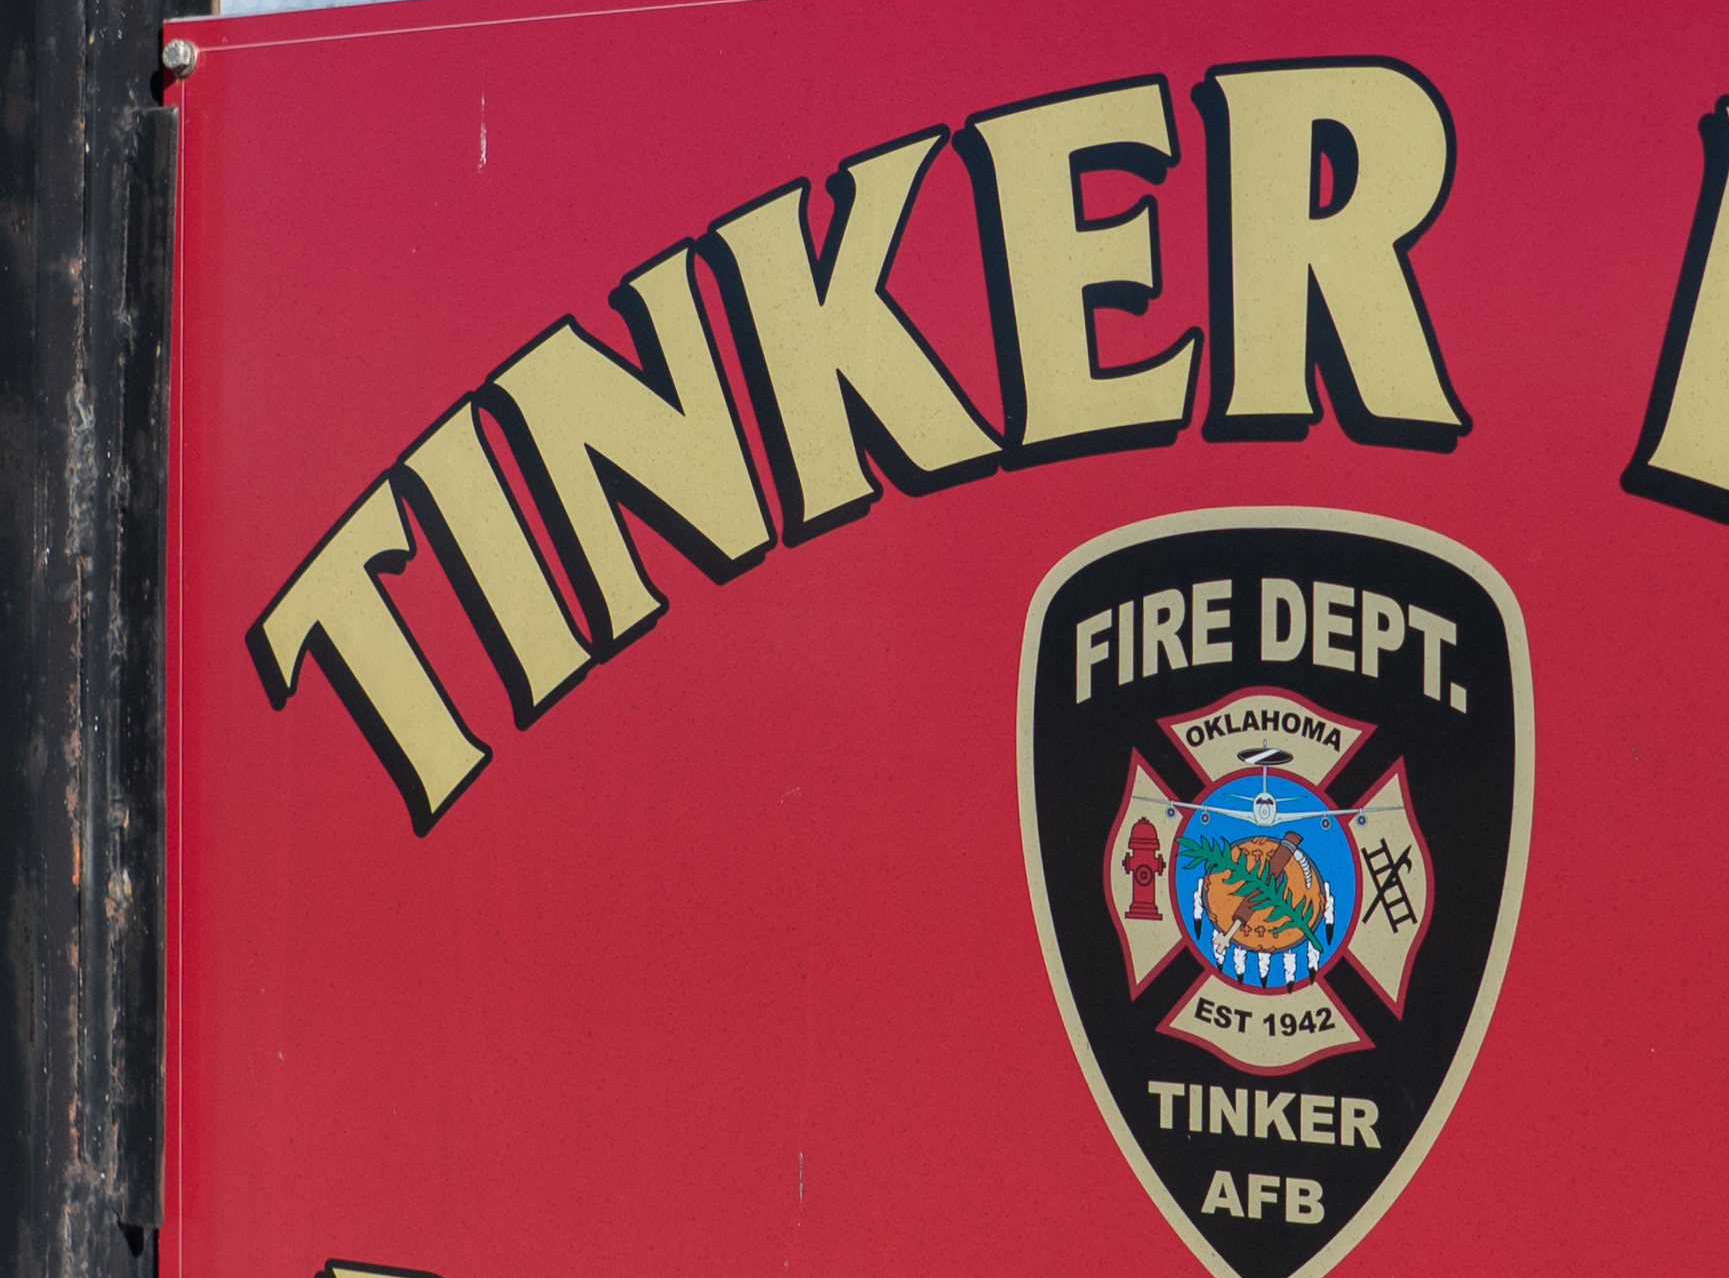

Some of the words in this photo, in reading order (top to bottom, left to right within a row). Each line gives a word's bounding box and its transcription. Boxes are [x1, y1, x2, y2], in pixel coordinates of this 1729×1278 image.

[245, 56, 1472, 835] TINKER
[1075, 578, 1234, 705] FIRE
[1260, 578, 1469, 715] DEPT.
[1185, 709, 1343, 753] OKLAHOMA
[1193, 997, 1253, 1035] EST
[1260, 1006, 1338, 1038] 1942
[1147, 1080, 1382, 1149] TINKER
[1200, 1169, 1326, 1225] AFB
